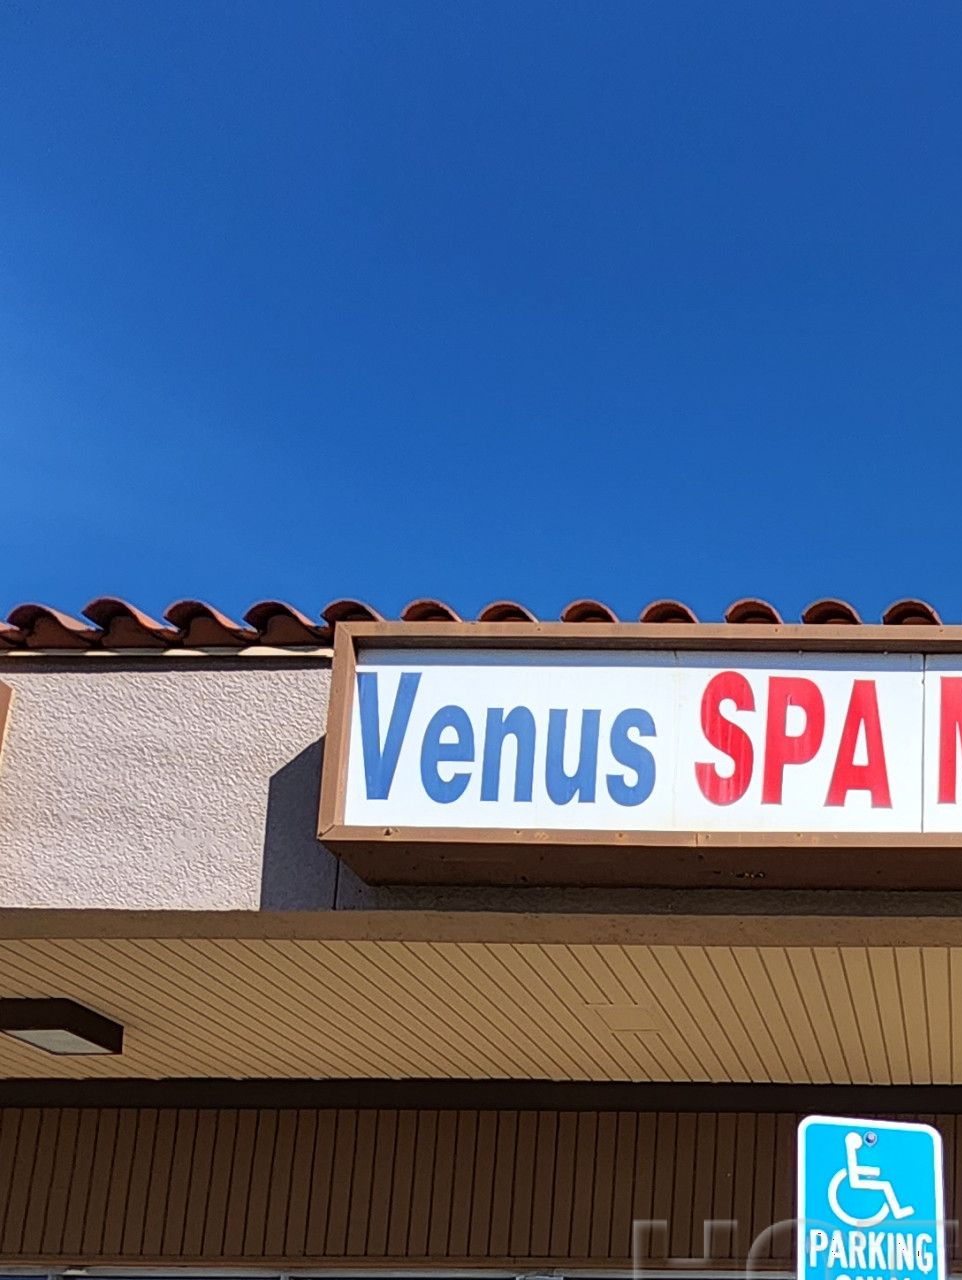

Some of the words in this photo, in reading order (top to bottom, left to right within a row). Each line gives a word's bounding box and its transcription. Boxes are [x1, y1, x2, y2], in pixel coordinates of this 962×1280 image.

[354, 670, 657, 806] Venus
[695, 670, 892, 809] SPA
[809, 1229, 934, 1273] PARKING
